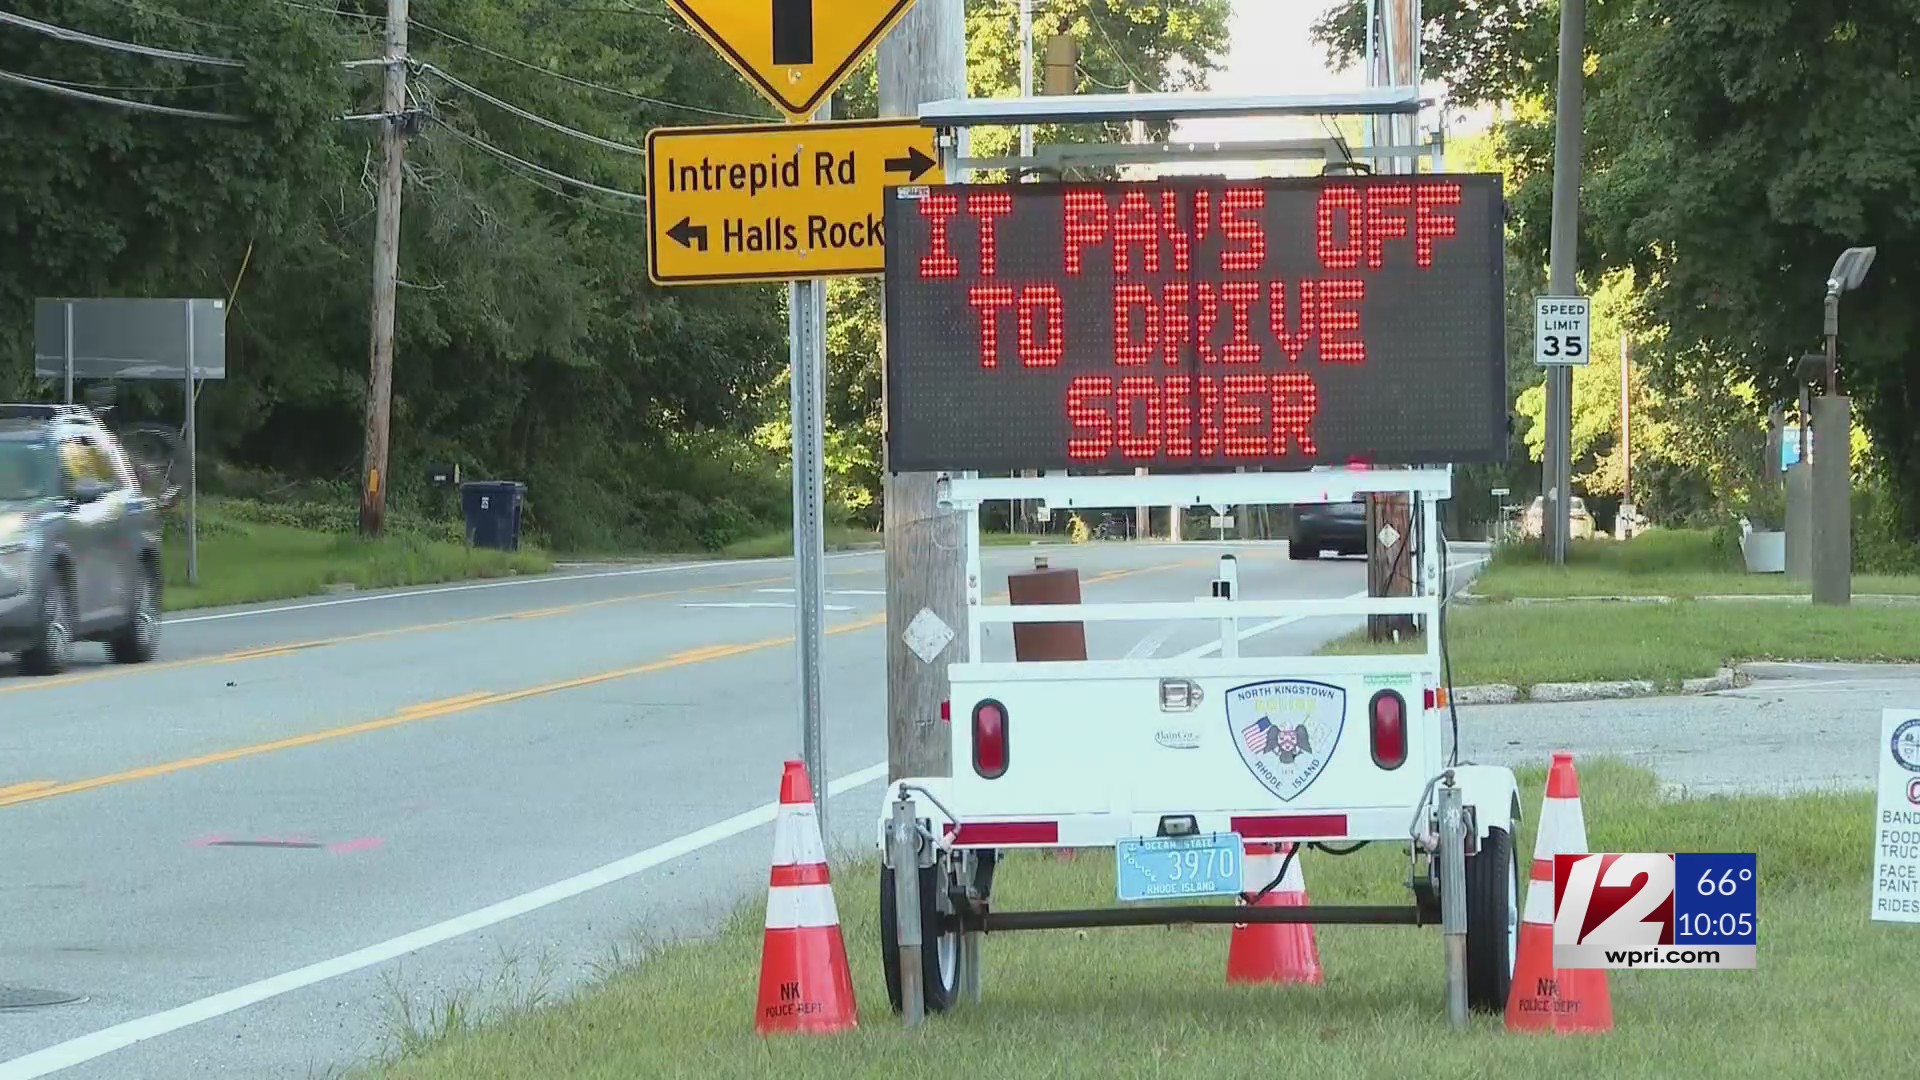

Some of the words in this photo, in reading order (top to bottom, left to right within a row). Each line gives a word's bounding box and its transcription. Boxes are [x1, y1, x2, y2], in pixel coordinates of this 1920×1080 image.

[669, 152, 799, 198] Intrepid
[815, 150, 855, 186] Rd
[724, 216, 798, 253] Halls
[808, 212, 885, 250] Rock
[918, 191, 1013, 278] IT
[1063, 187, 1266, 275] PAYS
[1316, 183, 1462, 270] OFF
[1541, 305, 1585, 315] SPEED
[968, 284, 1064, 369] TO
[1112, 278, 1367, 366] DRIVE
[1545, 320, 1580, 331] LIMIT
[1543, 335, 1582, 356] 35
[1066, 372, 1318, 459] SOBER
[1237, 686, 1271, 701] NORTH
[1274, 685, 1335, 700] KINGSTOWN
[1255, 760, 1284, 790] RHODE
[1291, 759, 1321, 789] ISLAND
[1144, 841, 1177, 851] OCEAN
[1183, 839, 1213, 849] STATE
[1168, 848, 1234, 881] 3970
[1880, 864, 1917, 879] FACE
[1147, 883, 1177, 895] RHODE
[1182, 881, 1216, 893] ISLAND
[1879, 878, 1919, 893] PAINT
[1878, 898, 1920, 913] RIDES
[780, 981, 800, 1000] NK
[1537, 978, 1559, 997] NK
[765, 1003, 795, 1018] POLICE
[1519, 998, 1551, 1012] POLICE
